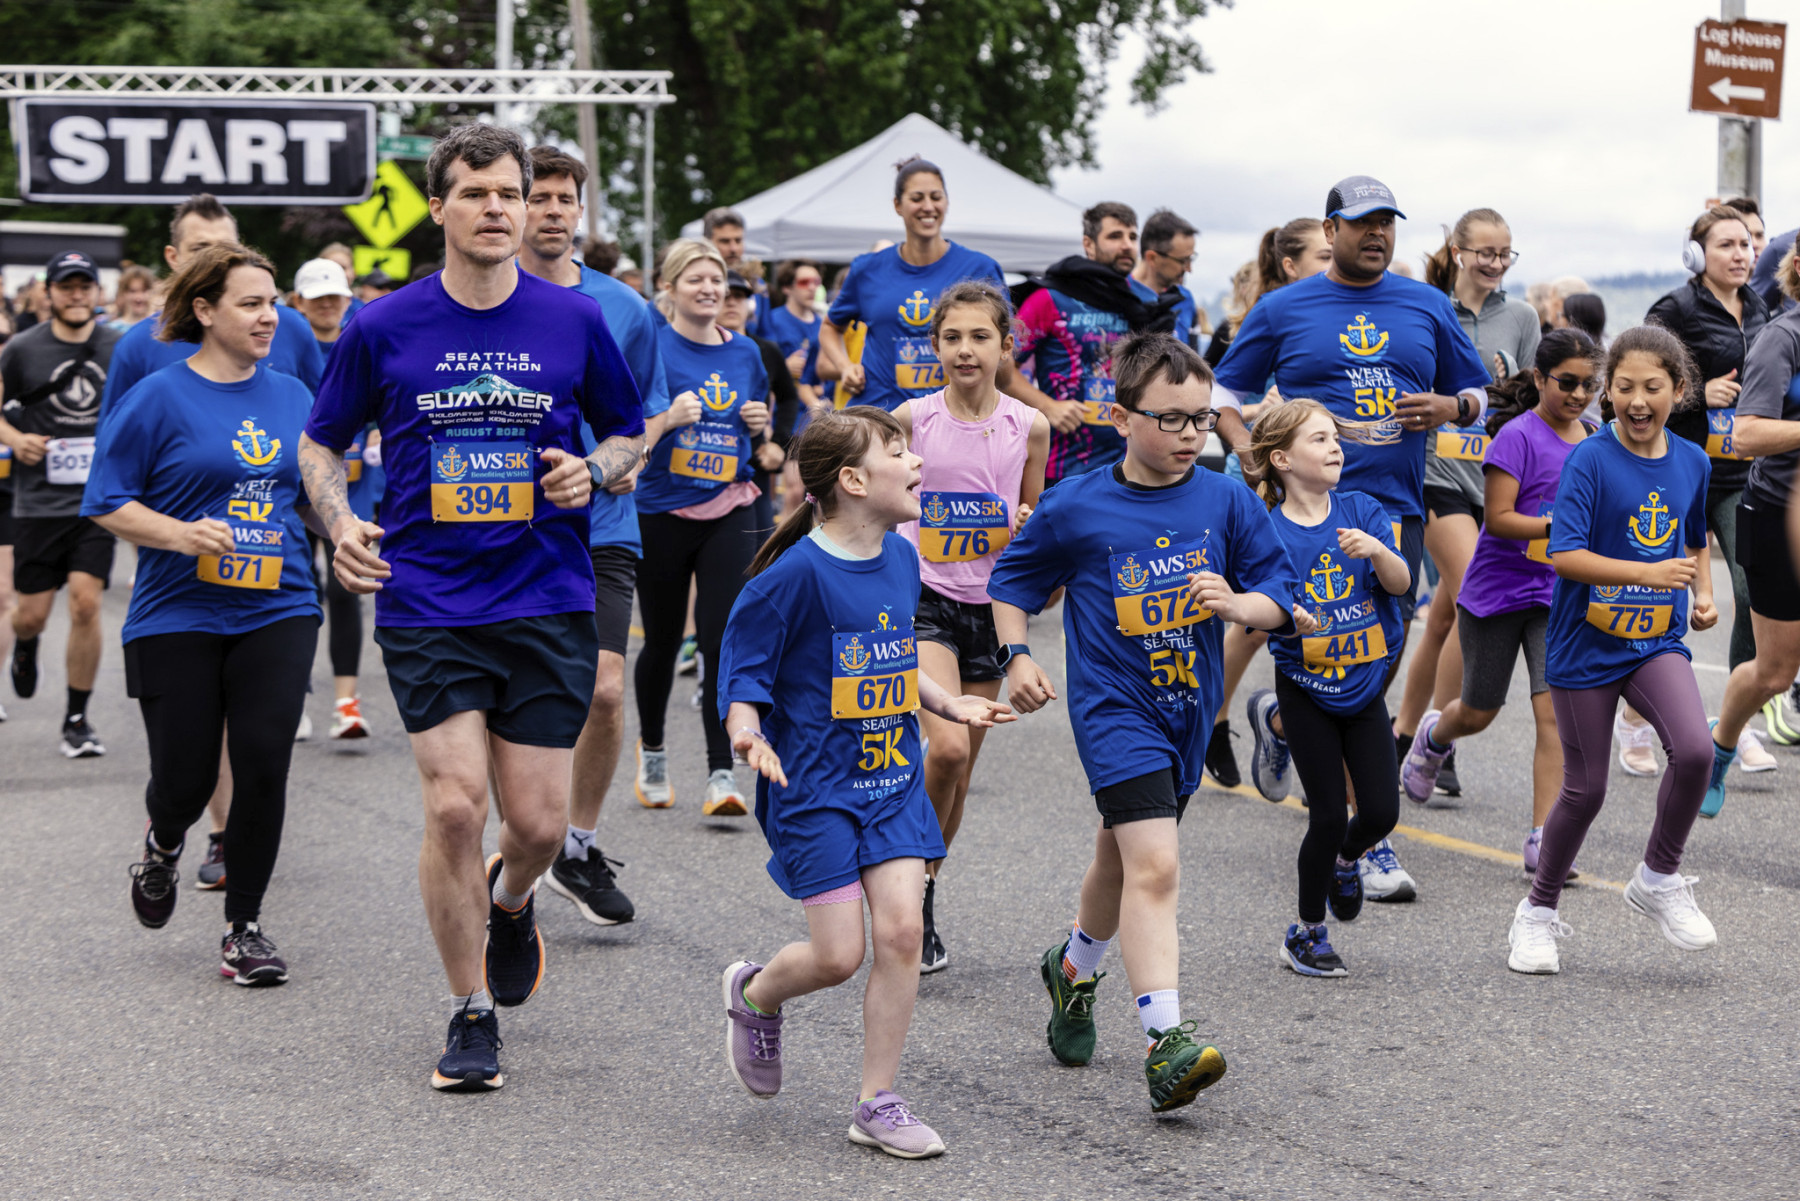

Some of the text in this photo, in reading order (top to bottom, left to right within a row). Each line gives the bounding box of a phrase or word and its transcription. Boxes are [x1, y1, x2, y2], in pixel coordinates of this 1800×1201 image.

[1700, 24, 1783, 50] Log House
[1704, 47, 1775, 73] Museum
[49, 115, 347, 185] START
[435, 362, 541, 372] MARATHON
[445, 352, 530, 362] SEATTLE
[911, 366, 945, 383] 774
[1345, 367, 1392, 380] WEST
[1351, 378, 1394, 388] SEATTLE
[416, 390, 553, 412] SUMMER
[1355, 387, 1398, 416] 5K
[445, 428, 526, 437] AUGUST 2022
[469, 452, 529, 469] WS5K
[686, 453, 723, 475] 440
[471, 471, 506, 479] Benefiting
[456, 485, 512, 515] 394
[950, 501, 1004, 516] WS5K
[939, 529, 990, 556] 776
[218, 554, 263, 582] 671
[1149, 548, 1209, 576] WS5K
[1153, 573, 1188, 586] Benefitin
[1141, 586, 1200, 626] 672
[1608, 606, 1655, 633] 775
[872, 636, 915, 660] WS5K
[1143, 636, 1195, 650] SEATTLE
[1325, 631, 1370, 662] 441
[1625, 641, 1649, 650] 2023
[1150, 649, 1200, 688] 5K
[857, 674, 906, 711] 670
[1292, 673, 1341, 693] ALKI BEACH
[862, 713, 903, 731] SEATTLE
[858, 727, 910, 771] 5K
[852, 773, 911, 789] ALKI BEACH
